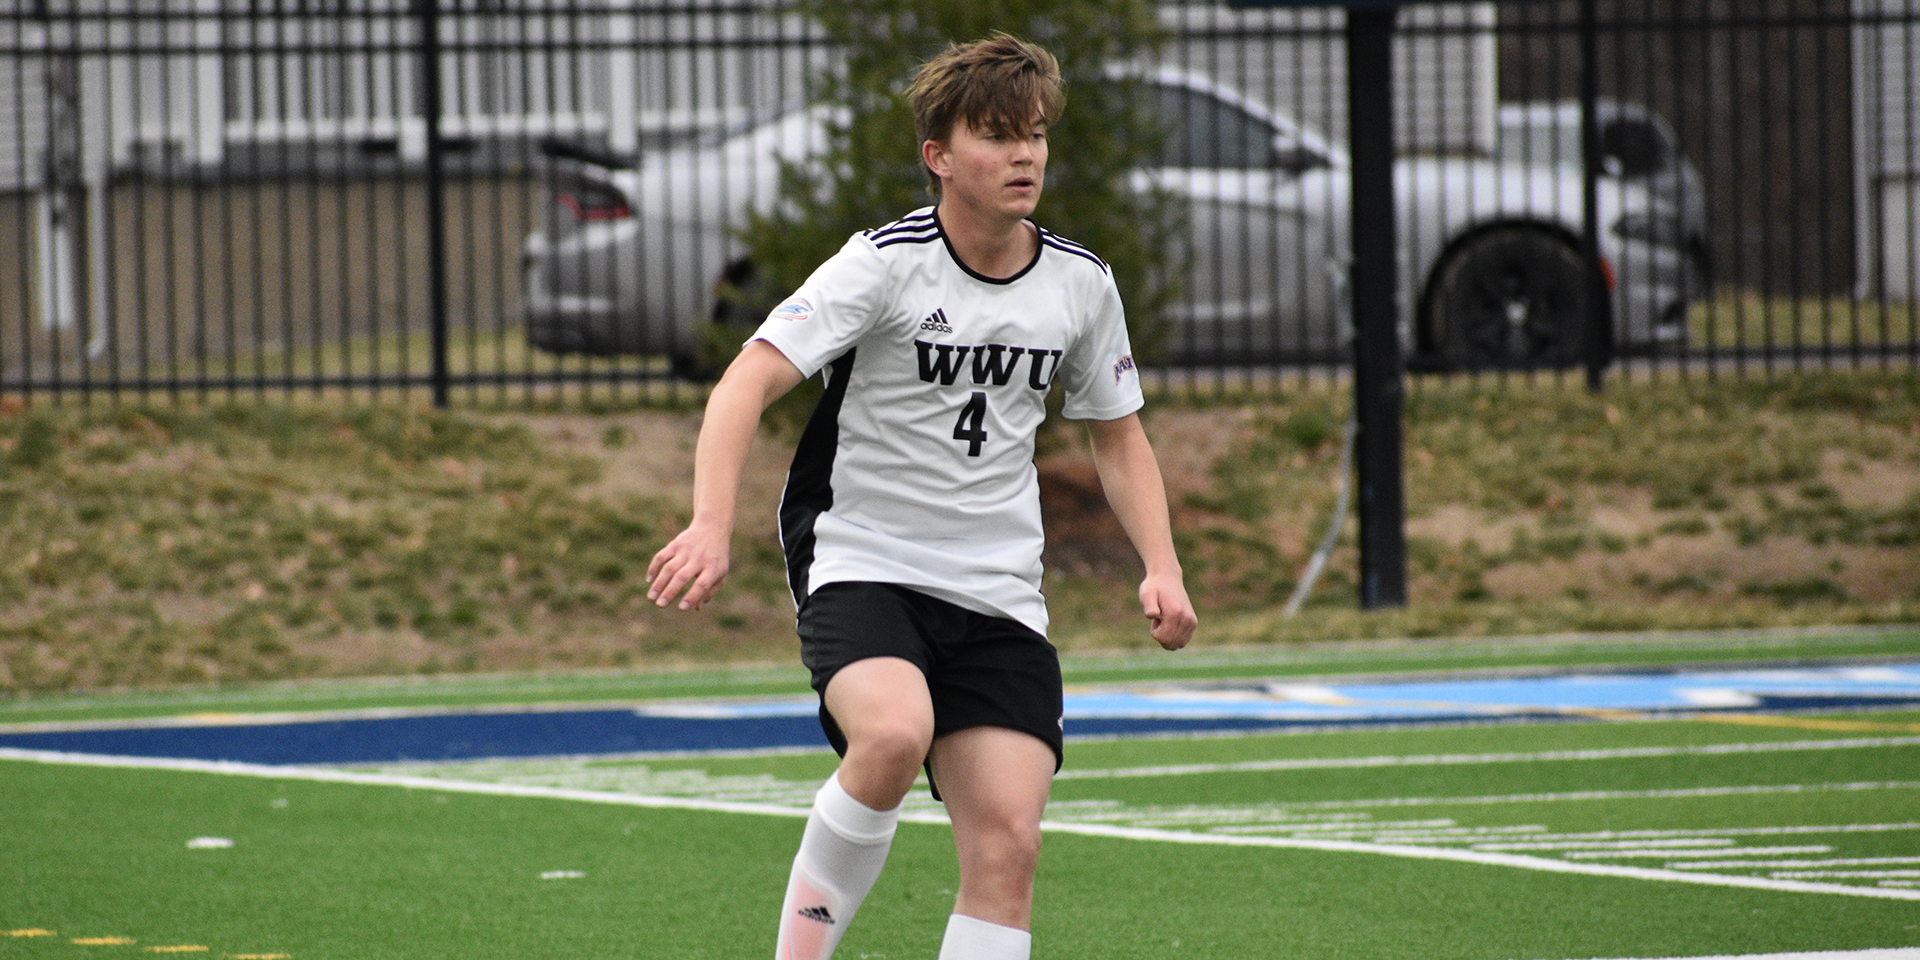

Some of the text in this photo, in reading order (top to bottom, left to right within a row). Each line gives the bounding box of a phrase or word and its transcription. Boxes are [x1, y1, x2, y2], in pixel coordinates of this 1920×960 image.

[920, 321, 953, 334] adidas
[914, 339, 1063, 390] WWU
[953, 391, 987, 457] 4
[798, 909, 836, 925] adidas
